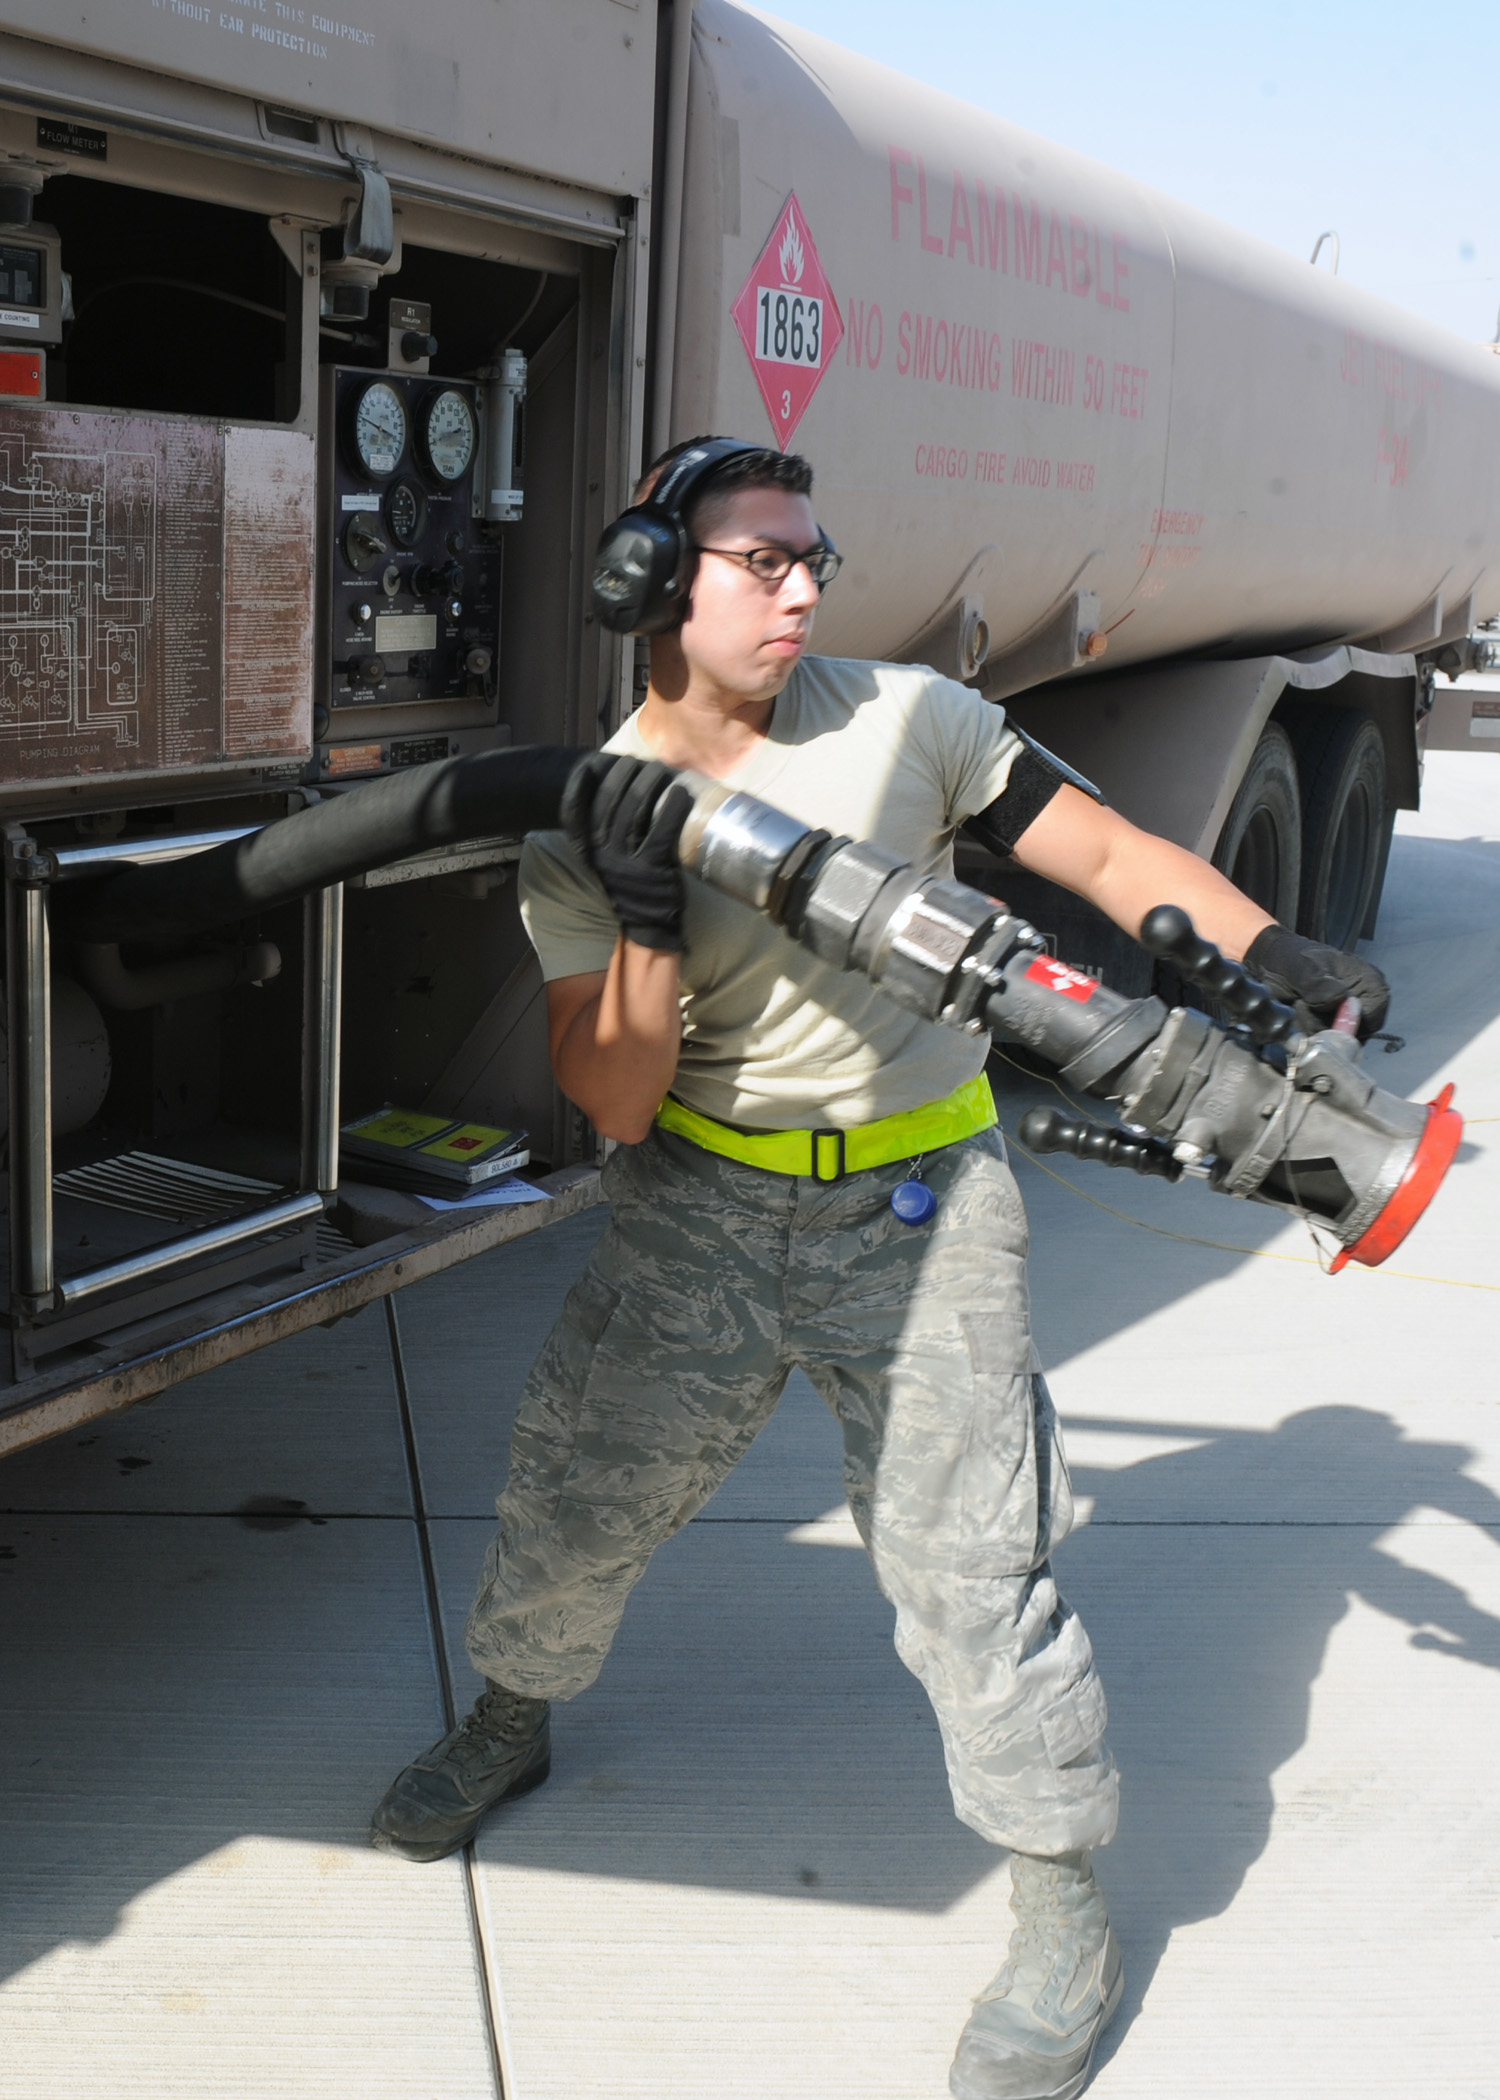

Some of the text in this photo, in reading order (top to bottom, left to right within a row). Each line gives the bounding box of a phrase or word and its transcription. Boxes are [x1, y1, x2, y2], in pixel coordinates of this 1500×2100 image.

[220, 13, 244, 35] EAR
[252, 24, 328, 59] PROTECTION
[275, 2, 304, 25] THIS
[312, 15, 376, 47] EQUIPMENT
[46, 130, 100, 151] FLOW METER
[888, 143, 1131, 312] FLAMMABLE
[760, 291, 822, 363] 1863
[846, 297, 1149, 419] NO SMOKING WITHIN 50 FEET
[780, 389, 792, 420] 3
[915, 444, 1095, 492] CARGO FIRE AVOID WATER
[20, 744, 100, 760] PUMPING DIAGRAM
